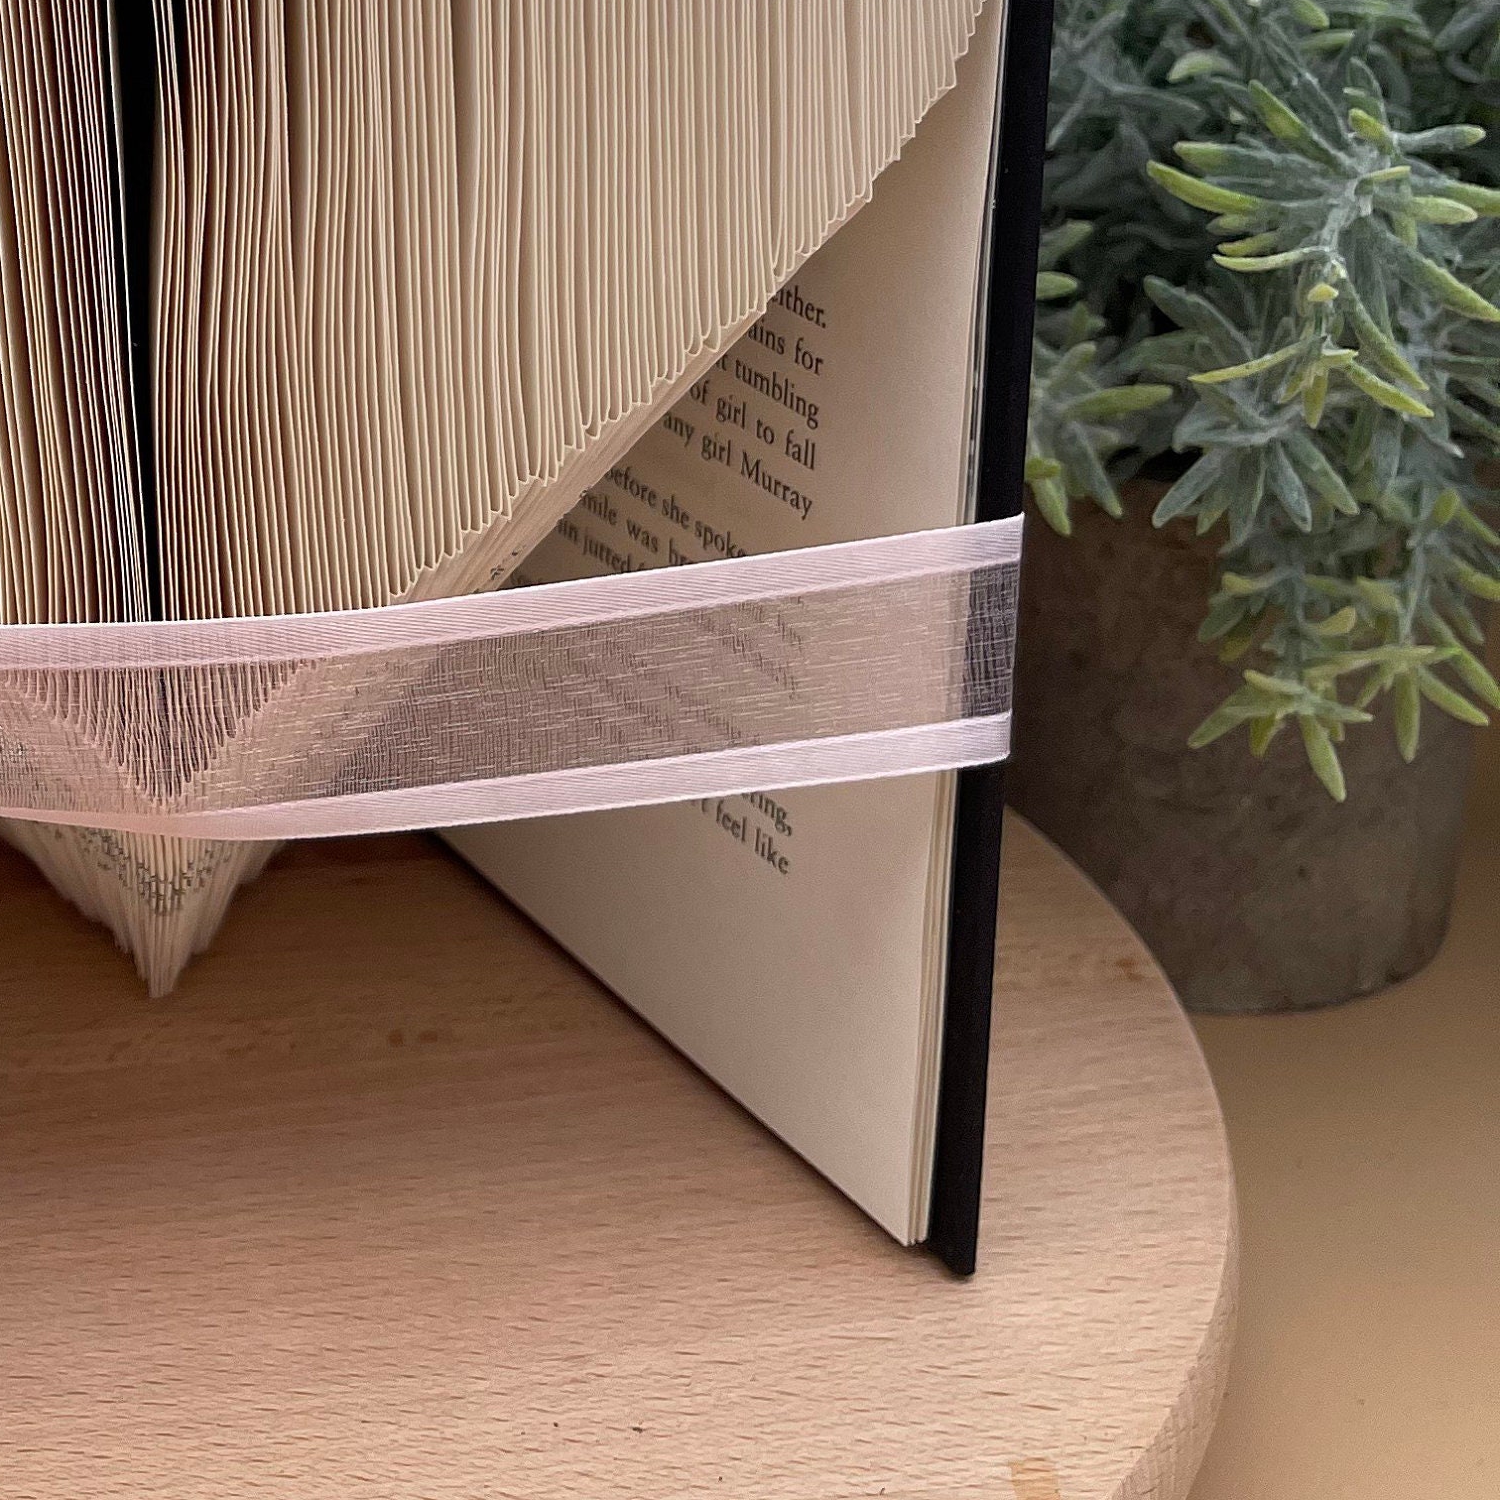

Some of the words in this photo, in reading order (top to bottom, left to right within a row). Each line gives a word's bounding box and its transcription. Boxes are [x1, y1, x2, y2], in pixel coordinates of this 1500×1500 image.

[771, 285, 826, 329] ither.
[748, 319, 785, 355] ains
[794, 337, 824, 374] for
[735, 358, 819, 430] tumbling
[690, 380, 709, 405] of
[716, 395, 746, 430] girl
[756, 419, 775, 445] to
[785, 429, 816, 470] fall
[662, 413, 695, 448] any
[701, 432, 732, 467] girl
[741, 452, 813, 521] Murray
[627, 518, 659, 553] was
[661, 494, 690, 530] she
[716, 800, 747, 842] feel
[755, 827, 789, 875] like
[743, 792, 792, 836] ing,
